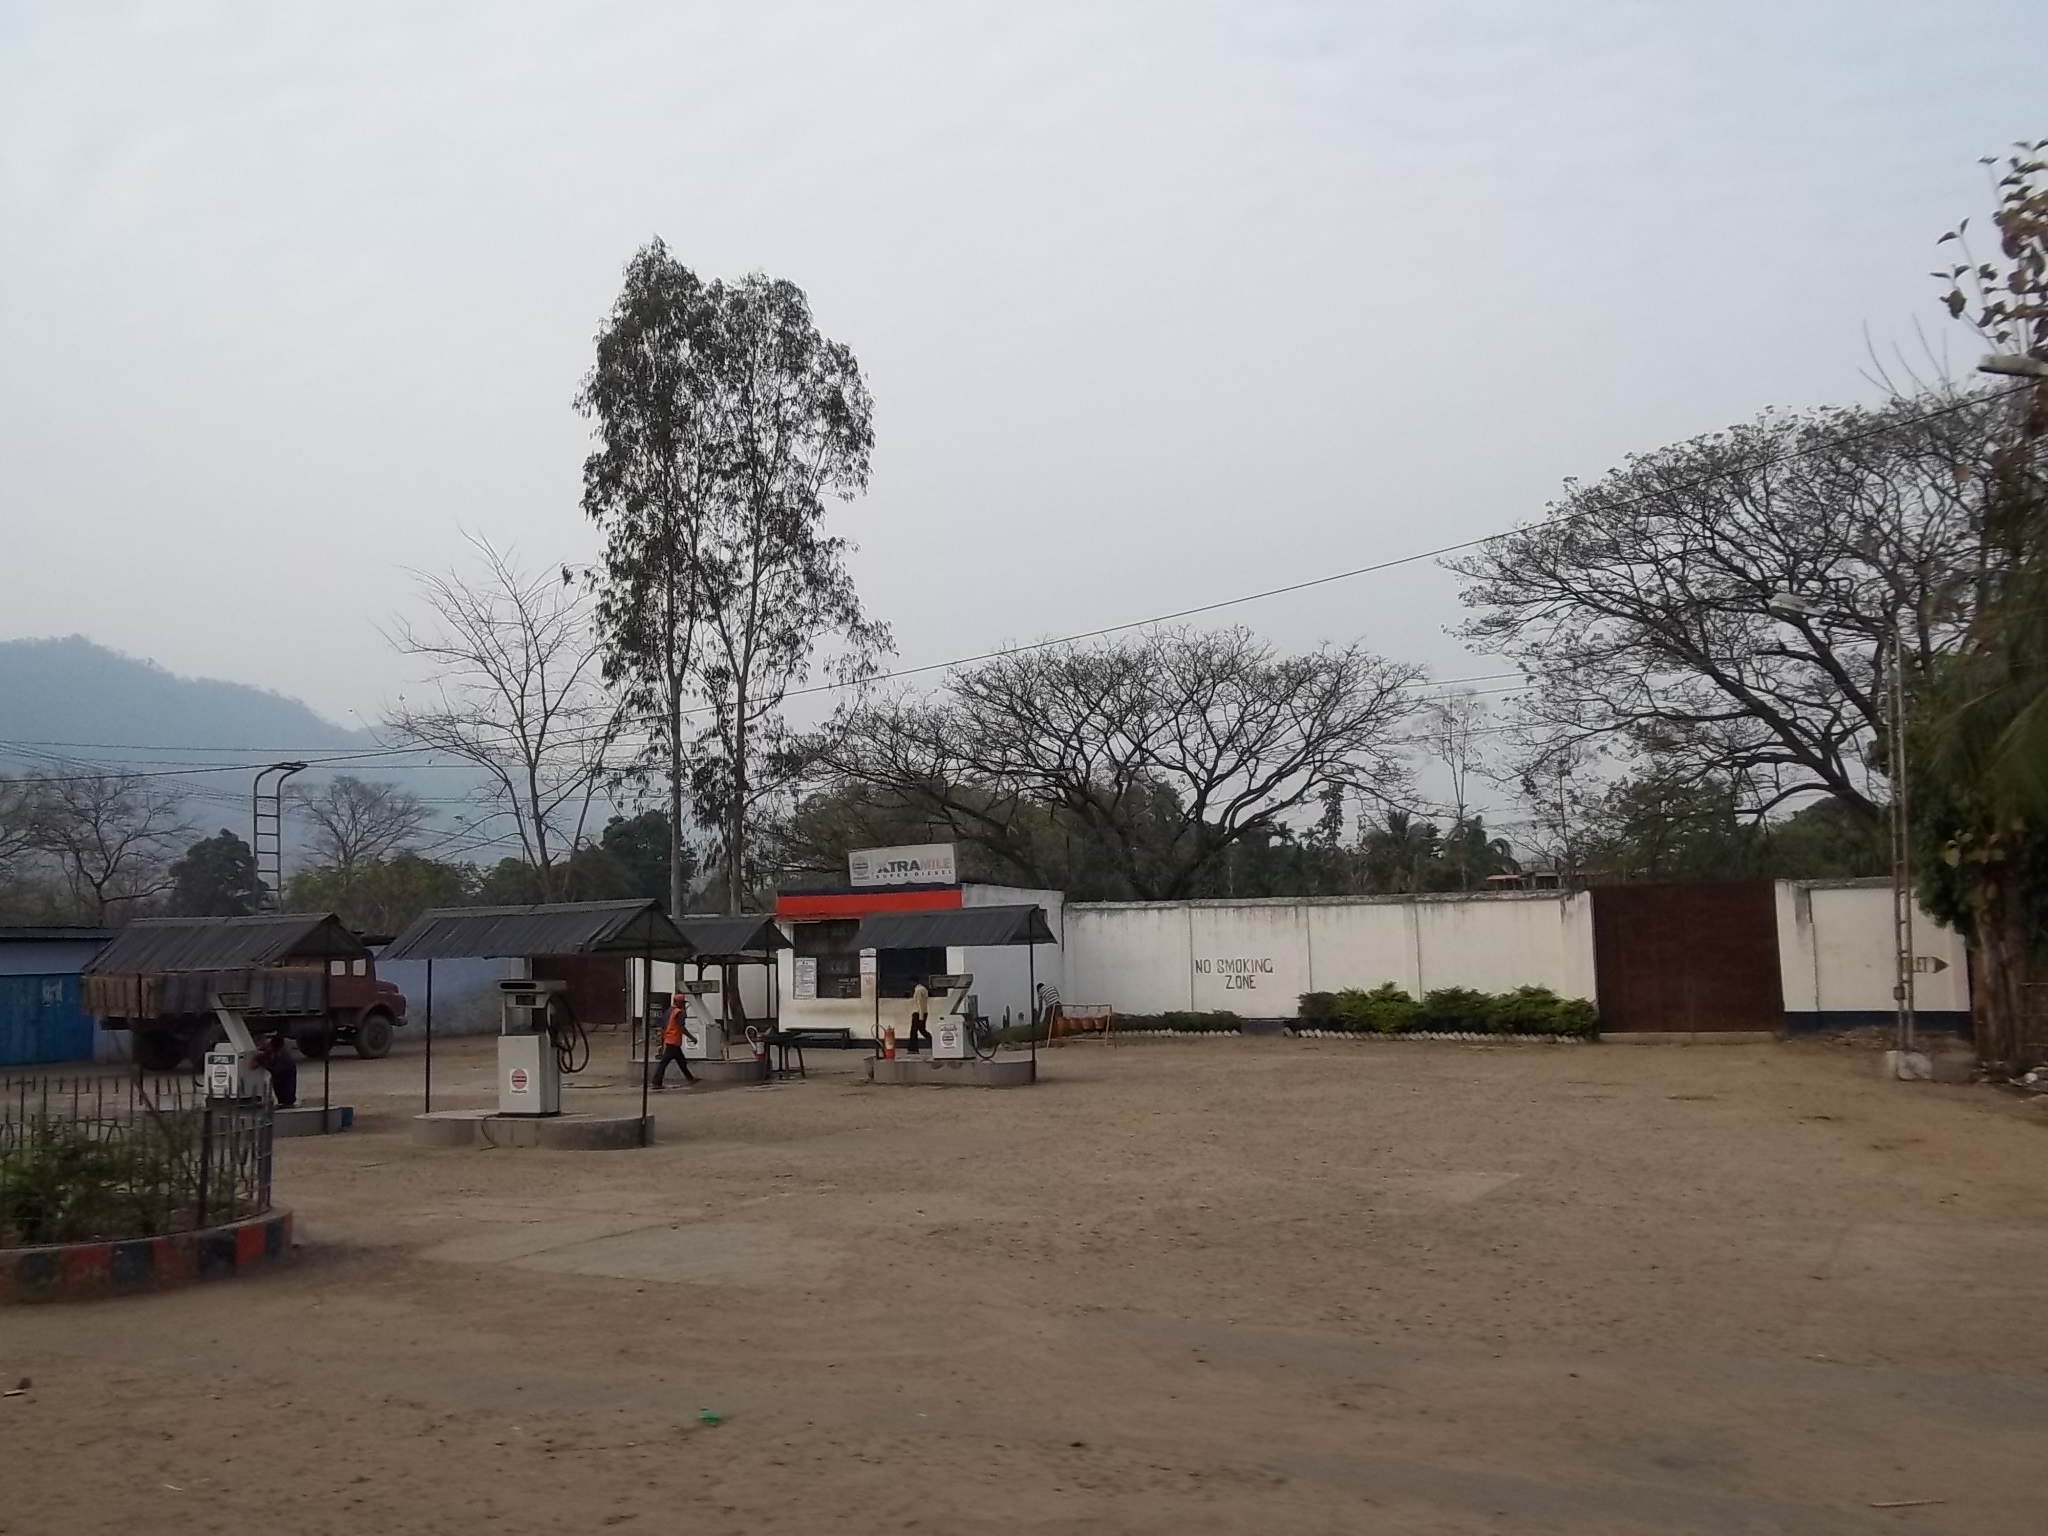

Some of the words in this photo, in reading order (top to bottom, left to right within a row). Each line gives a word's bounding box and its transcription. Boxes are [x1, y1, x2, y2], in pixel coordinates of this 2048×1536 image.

[914, 869, 953, 877] DIESEL
[1195, 959, 1211, 973] NO
[1217, 958, 1273, 973] SMOKING
[1225, 974, 1256, 989] ZONE
